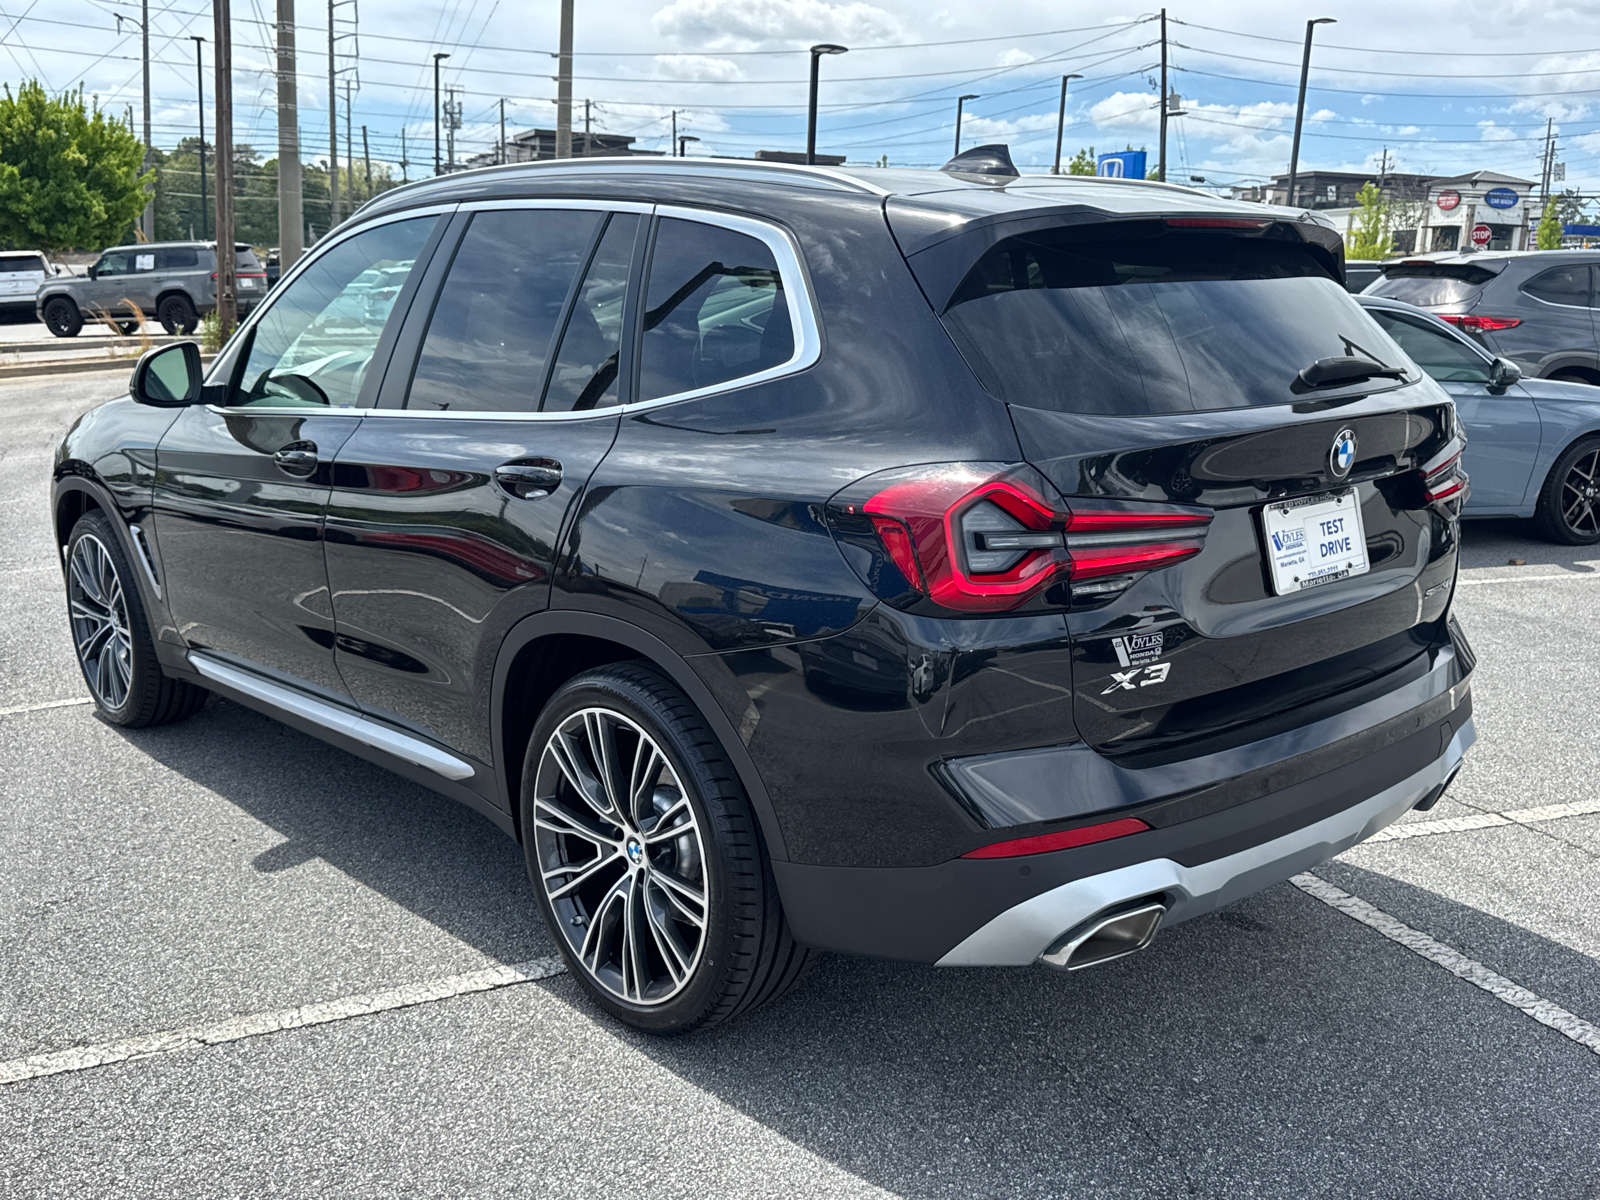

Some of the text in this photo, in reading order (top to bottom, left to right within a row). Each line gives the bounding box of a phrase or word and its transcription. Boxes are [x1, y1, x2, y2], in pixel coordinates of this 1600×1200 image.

[1472, 231, 1490, 239] STOP
[1319, 518, 1344, 536] TEST
[1275, 530, 1304, 549] VOYLES
[1285, 542, 1304, 551] HONDA
[1320, 537, 1352, 558] DRIVE
[1123, 634, 1162, 655] VOYLES
[1129, 650, 1155, 660] HONDA
[1100, 662, 1171, 695] X3
